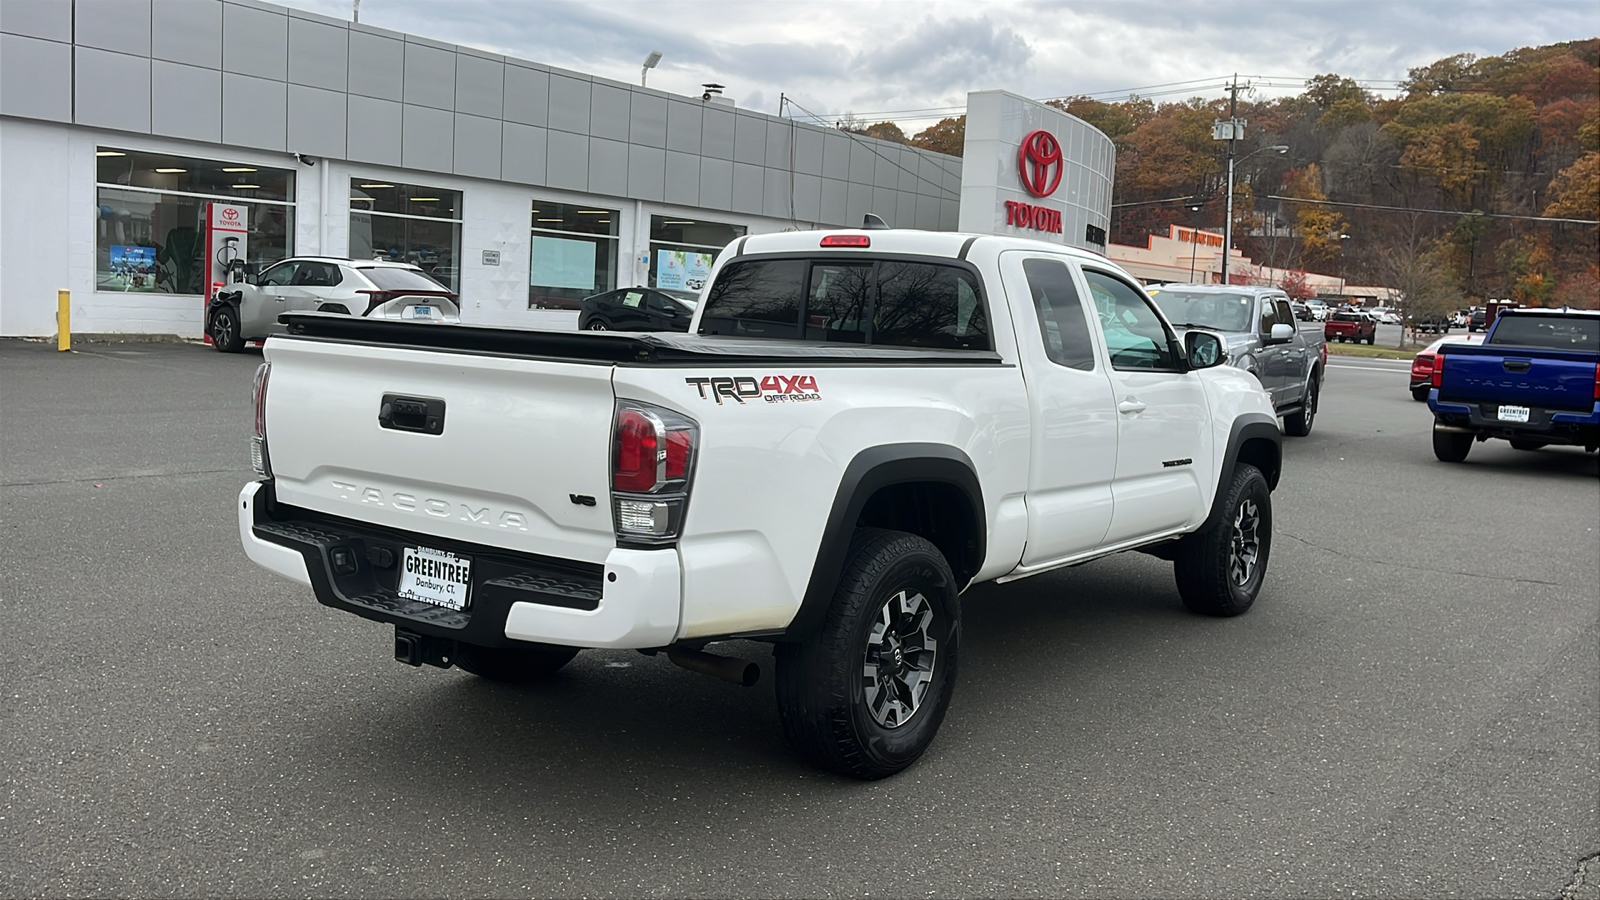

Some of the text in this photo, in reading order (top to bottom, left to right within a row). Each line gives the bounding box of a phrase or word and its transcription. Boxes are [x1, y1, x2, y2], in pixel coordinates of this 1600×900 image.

[1004, 200, 1063, 234] TOYOTA
[1465, 379, 1567, 392] TACOMA
[764, 393, 822, 403] OFF ROAD
[1499, 407, 1528, 416] GREENTREE
[332, 481, 528, 531] TACOMA
[568, 494, 597, 506] V6
[406, 555, 468, 584] GREENTREE
[416, 577, 456, 594] Danbury, CT.
[398, 591, 461, 611] GREENTREE
